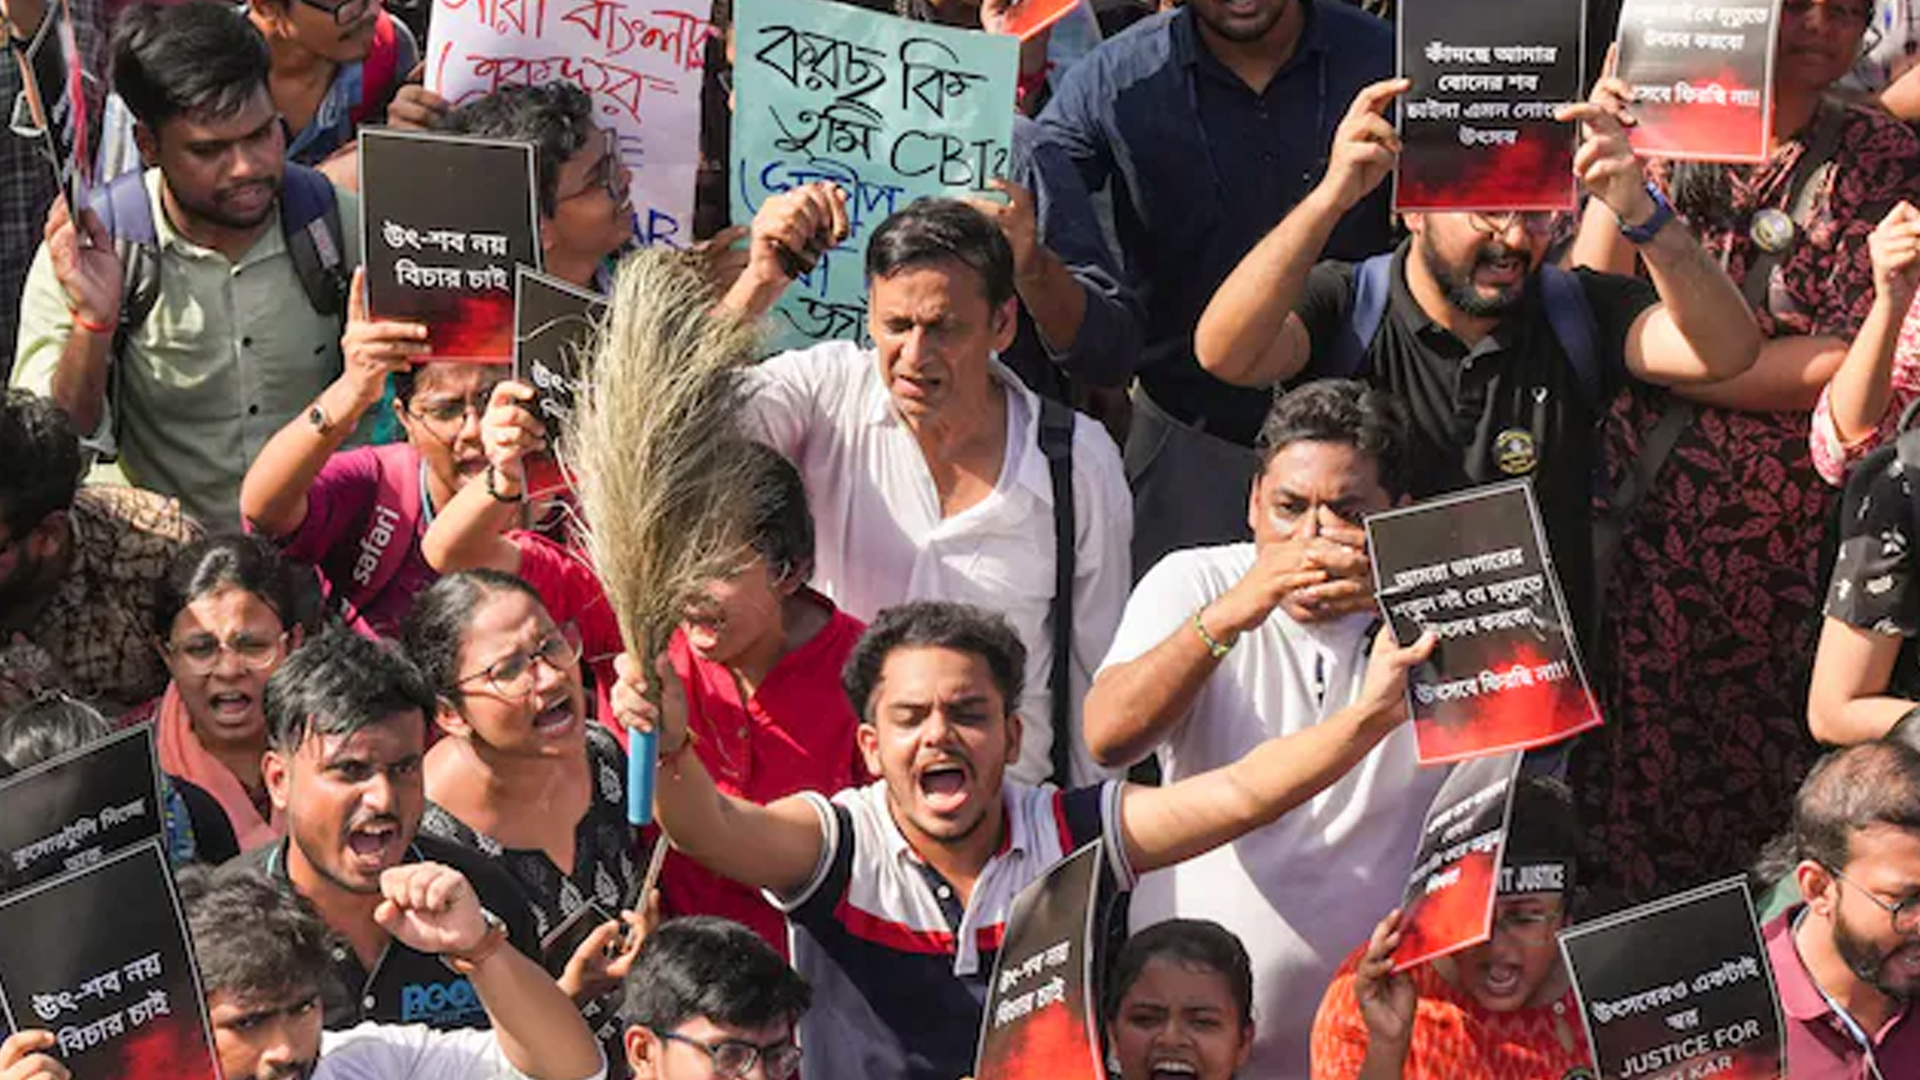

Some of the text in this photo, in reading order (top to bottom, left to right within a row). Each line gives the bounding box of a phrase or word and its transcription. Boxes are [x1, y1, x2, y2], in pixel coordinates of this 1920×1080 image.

[1493, 46, 1558, 64] আমার
[1437, 73, 1503, 92] বোনের
[1462, 102, 1509, 119] এমন
[469, 233, 508, 256] নয়
[394, 257, 512, 294] বিচার চাই
[352, 505, 401, 587] safari
[1515, 863, 1565, 891] JUSTICE
[31, 951, 163, 1021] উৎ-শব নয়
[56, 990, 171, 1058] বিচার চাই
[1619, 1018, 1761, 1079] JUSTICE FOR
